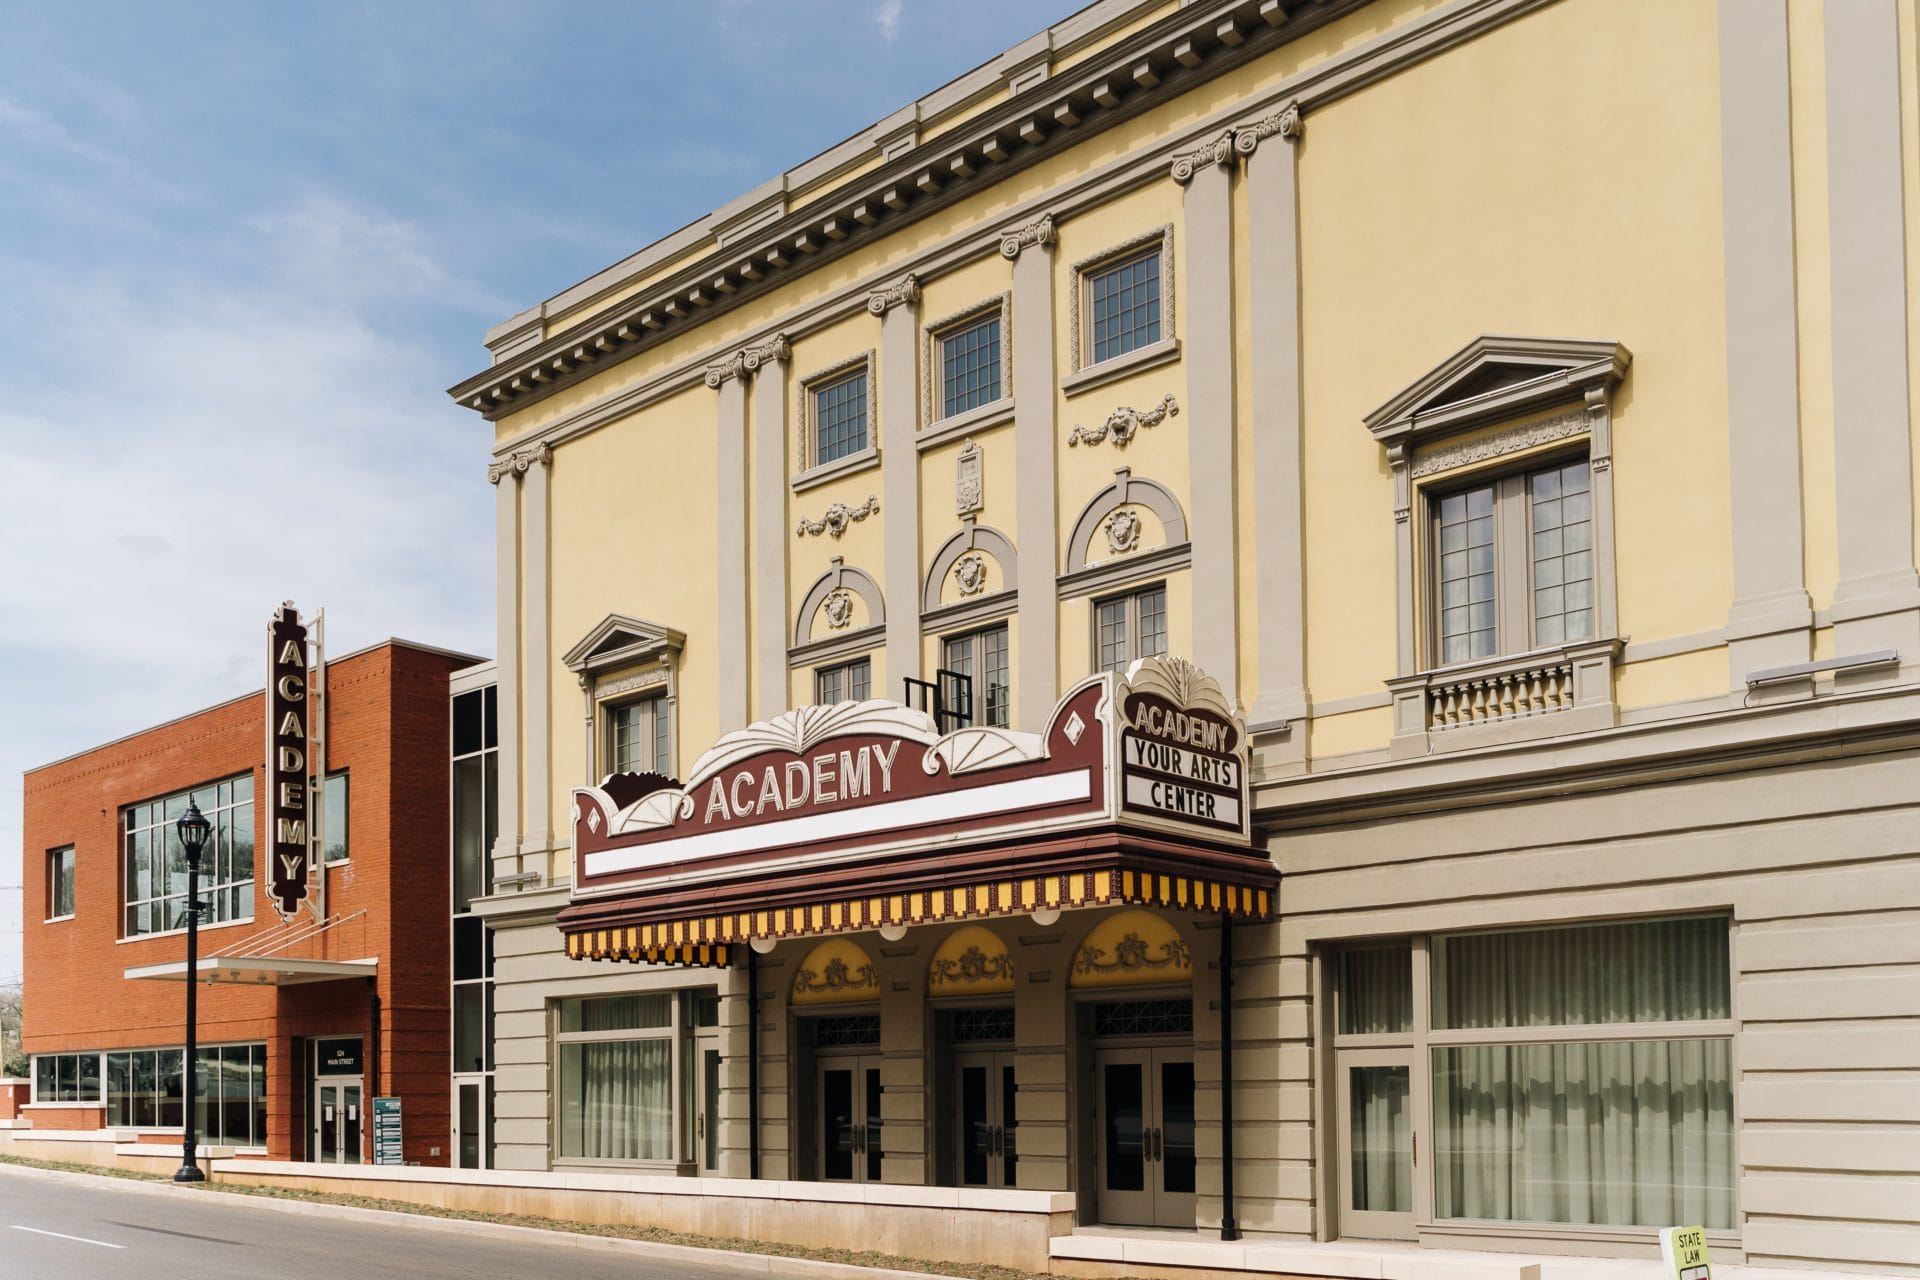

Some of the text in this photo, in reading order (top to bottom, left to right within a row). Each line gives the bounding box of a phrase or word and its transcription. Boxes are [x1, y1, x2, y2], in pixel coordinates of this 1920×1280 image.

[1134, 702, 1228, 752] ACADEMY
[277, 639, 306, 881] ACADEMY
[704, 740, 901, 824] ACADEMY
[1135, 739, 1231, 785] YOUR ARTS
[1151, 782, 1216, 818] CENTER
[1679, 1232, 1701, 1248] STATE
[1684, 1250, 1700, 1264] LAW
